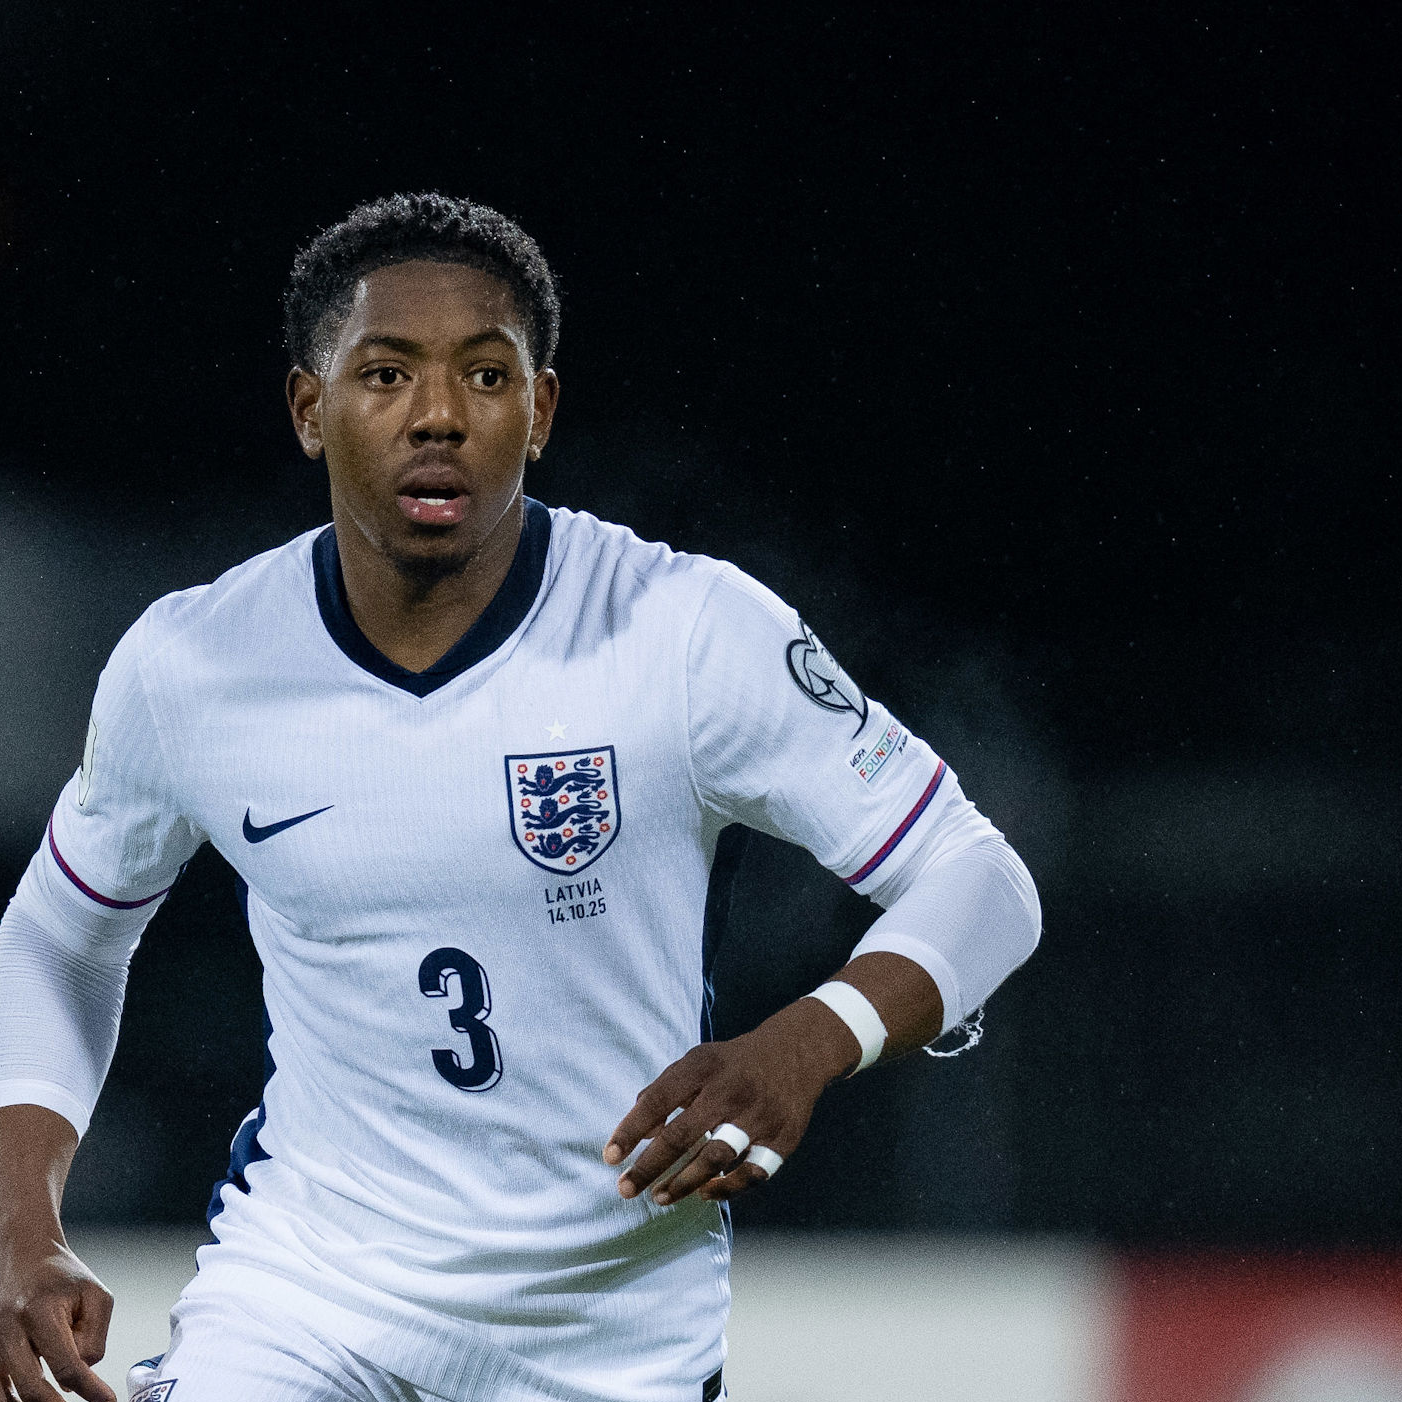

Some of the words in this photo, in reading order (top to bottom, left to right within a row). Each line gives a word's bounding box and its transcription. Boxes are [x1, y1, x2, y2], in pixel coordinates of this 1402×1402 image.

[544, 877, 603, 904] LATVIA
[547, 897, 607, 924] 14.10.25
[418, 946, 503, 1093] 3
